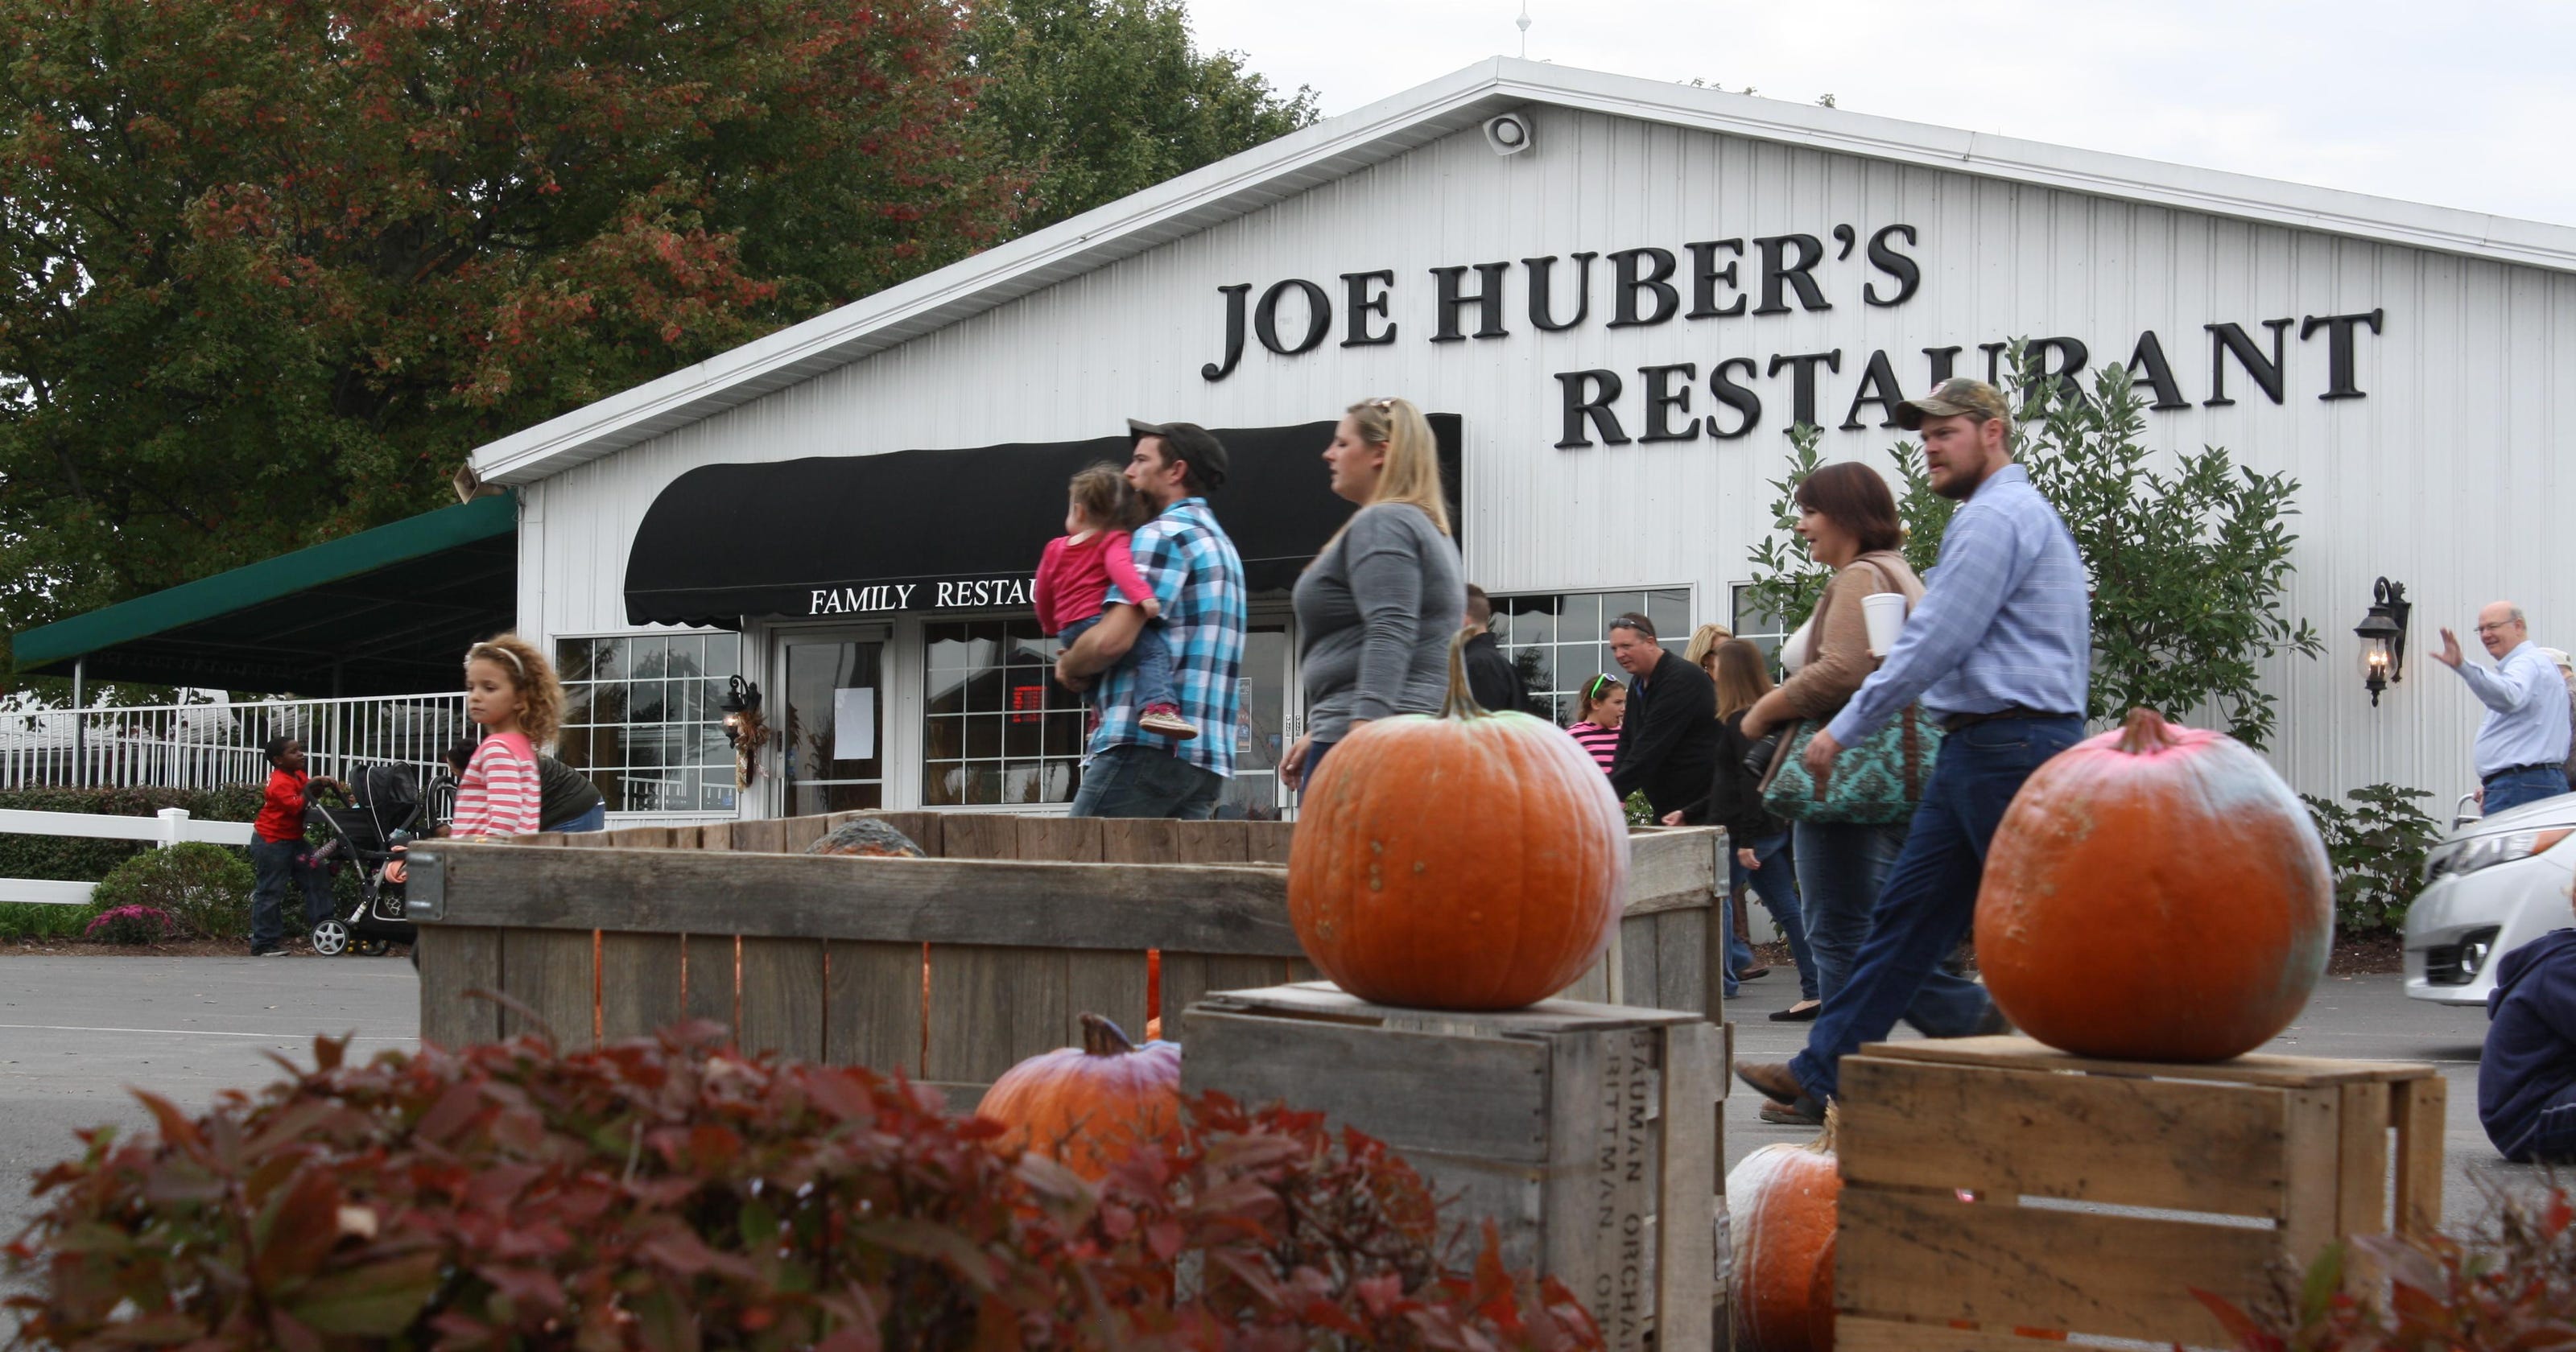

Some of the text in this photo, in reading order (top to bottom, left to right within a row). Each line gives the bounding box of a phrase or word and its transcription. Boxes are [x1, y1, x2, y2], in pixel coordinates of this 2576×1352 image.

[1201, 223, 1921, 382] JOE HUBER'S
[808, 583, 916, 615] FAMILY
[1625, 1030, 1649, 1183] BAUMAN
